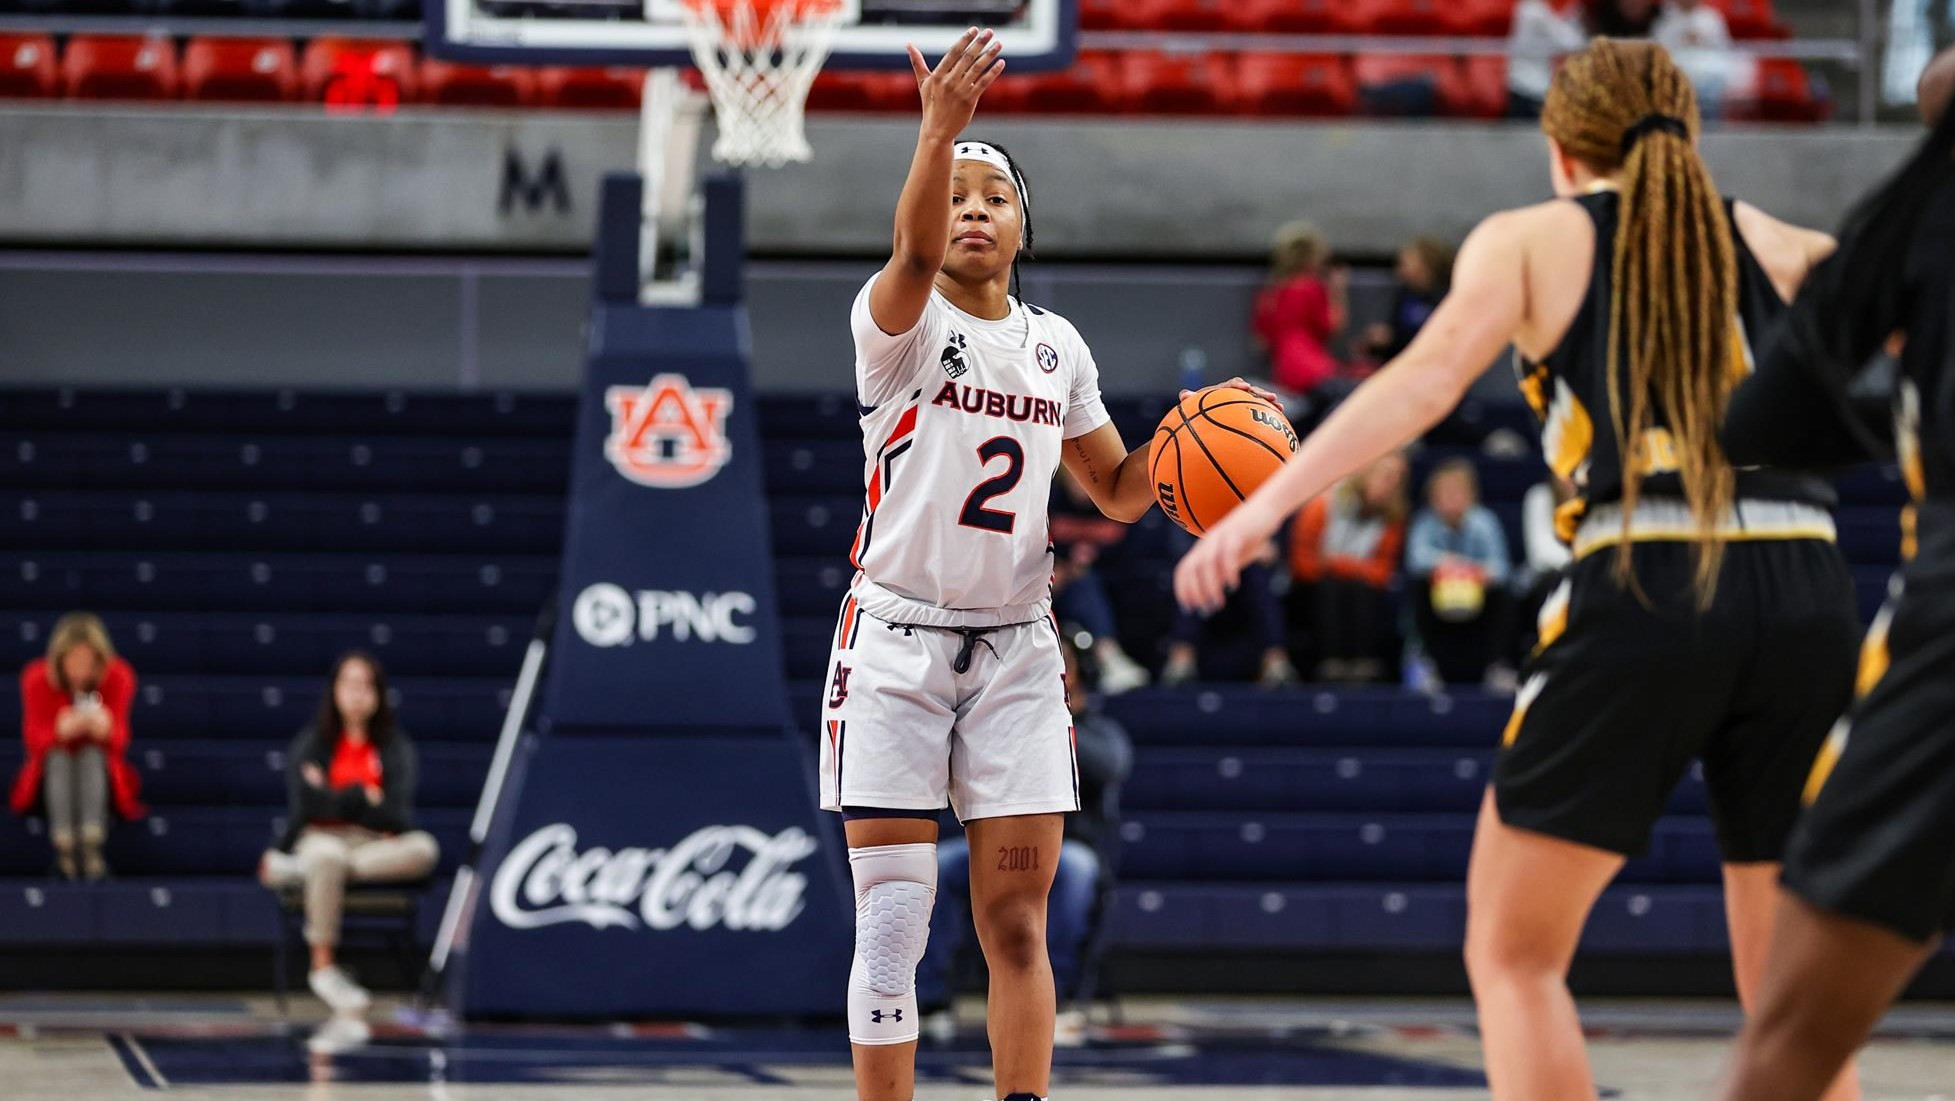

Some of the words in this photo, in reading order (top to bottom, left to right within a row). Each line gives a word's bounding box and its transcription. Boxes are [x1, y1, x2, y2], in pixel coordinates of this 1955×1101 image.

[931, 380, 1061, 427] AUBURN
[957, 435, 1025, 535] 2
[638, 589, 757, 644] PNC
[997, 845, 1039, 871] 2001
